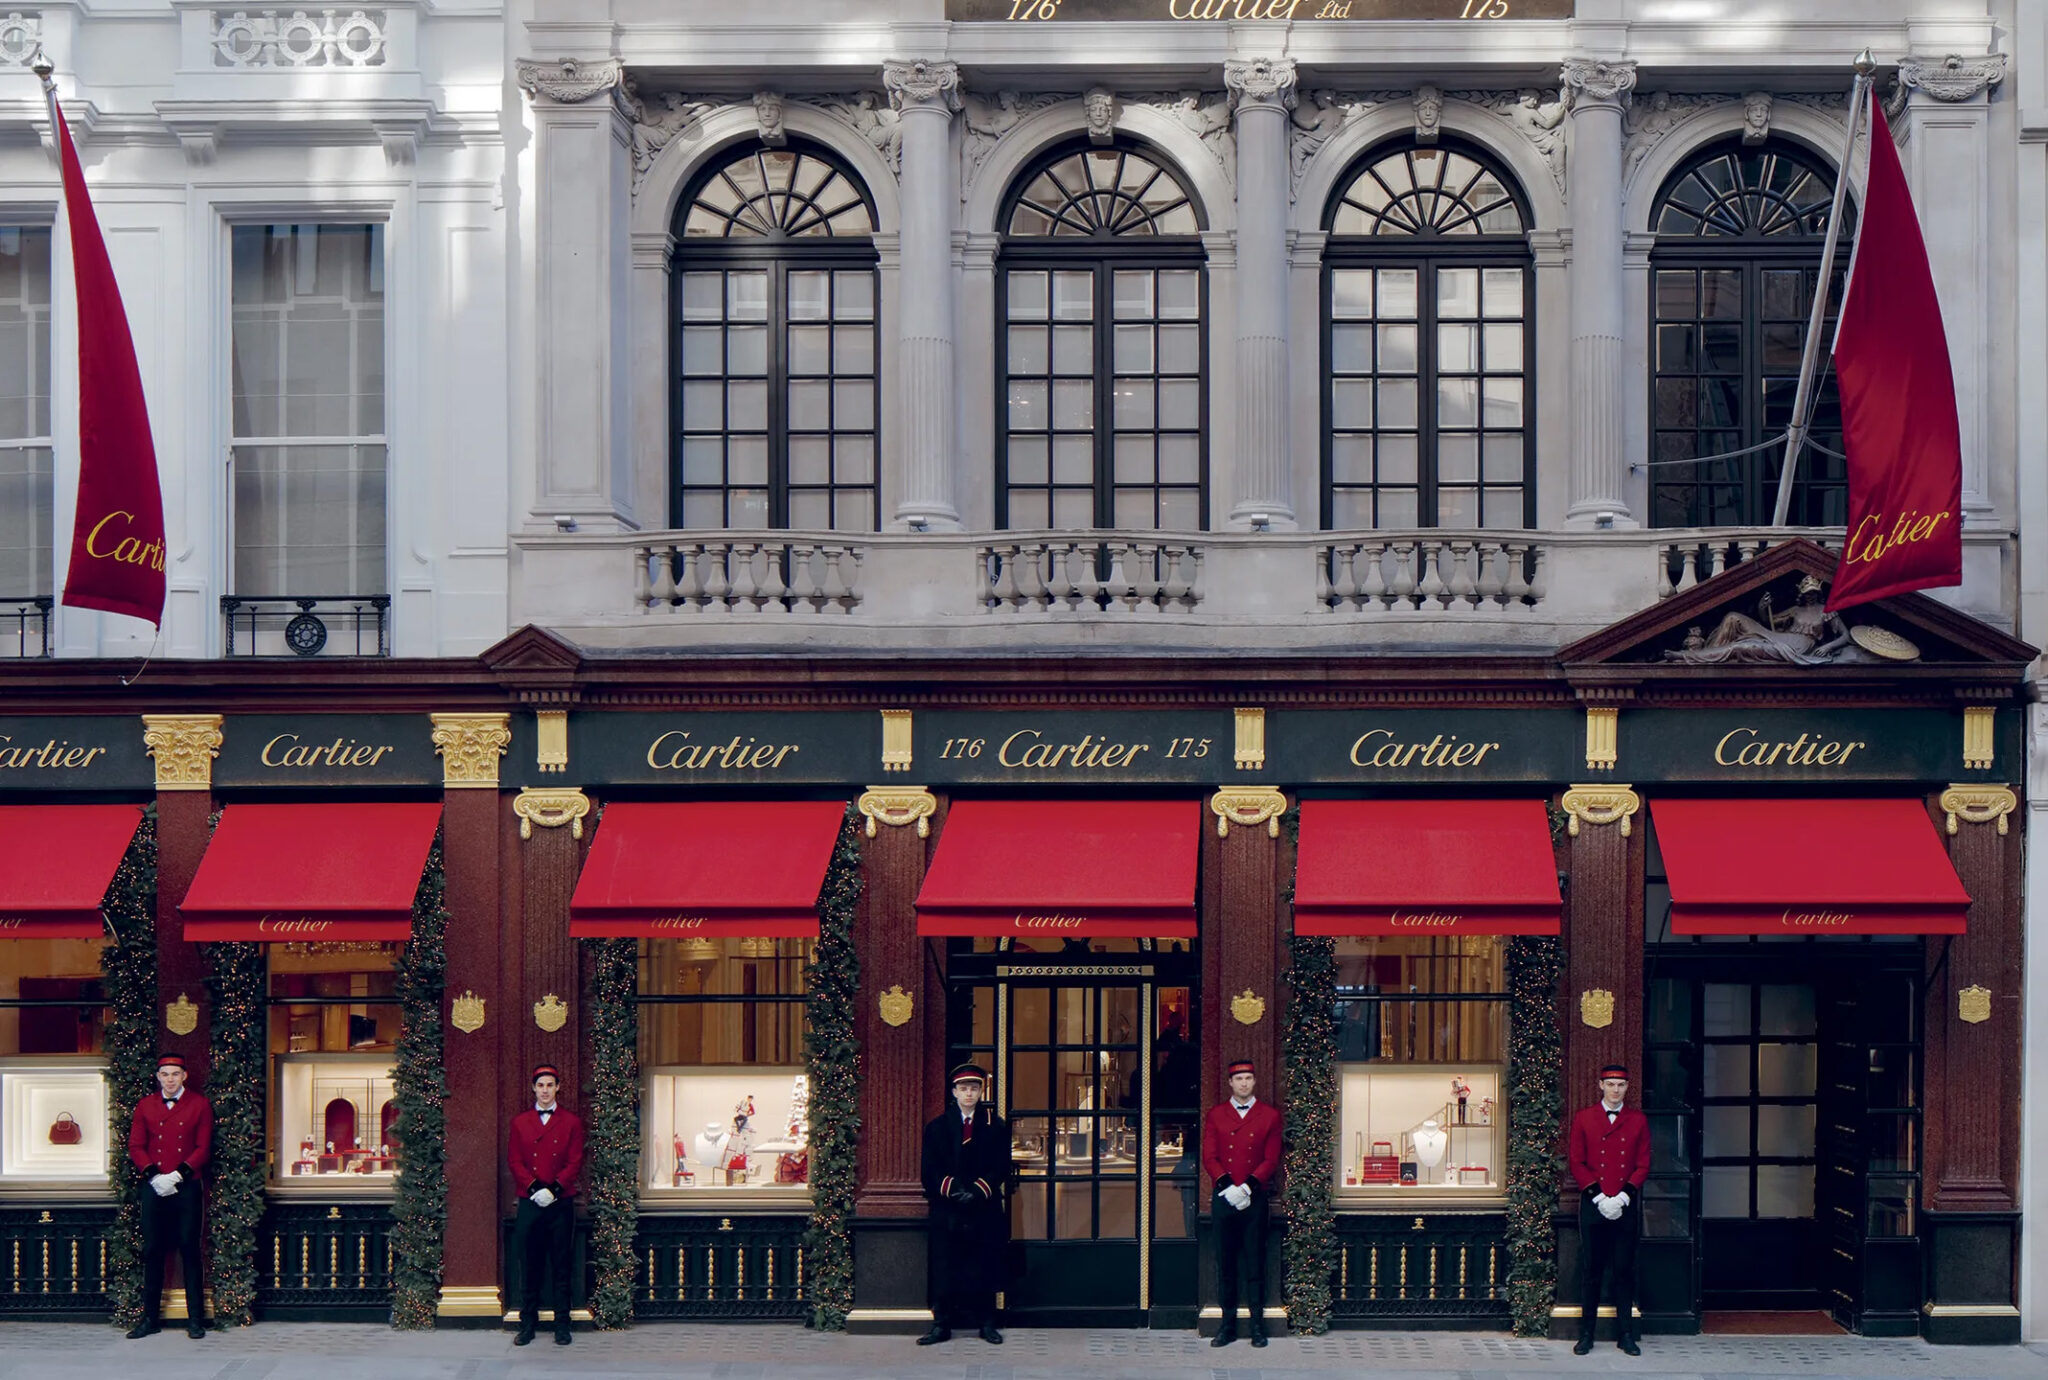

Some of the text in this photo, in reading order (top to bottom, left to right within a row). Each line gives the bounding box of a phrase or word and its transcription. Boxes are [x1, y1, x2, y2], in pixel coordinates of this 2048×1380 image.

[1315, 0, 1350, 19] Ltd
[0, 735, 106, 768] artier
[260, 732, 394, 768] Cartier
[647, 730, 799, 769] Cartier
[940, 729, 1212, 769] 176 Cartier 175
[1350, 729, 1500, 768] Cartier
[1714, 727, 1866, 767] Cartier
[259, 913, 333, 932] Cartier
[1390, 909, 1462, 926] Cartier
[1782, 908, 1853, 925] Cartier
